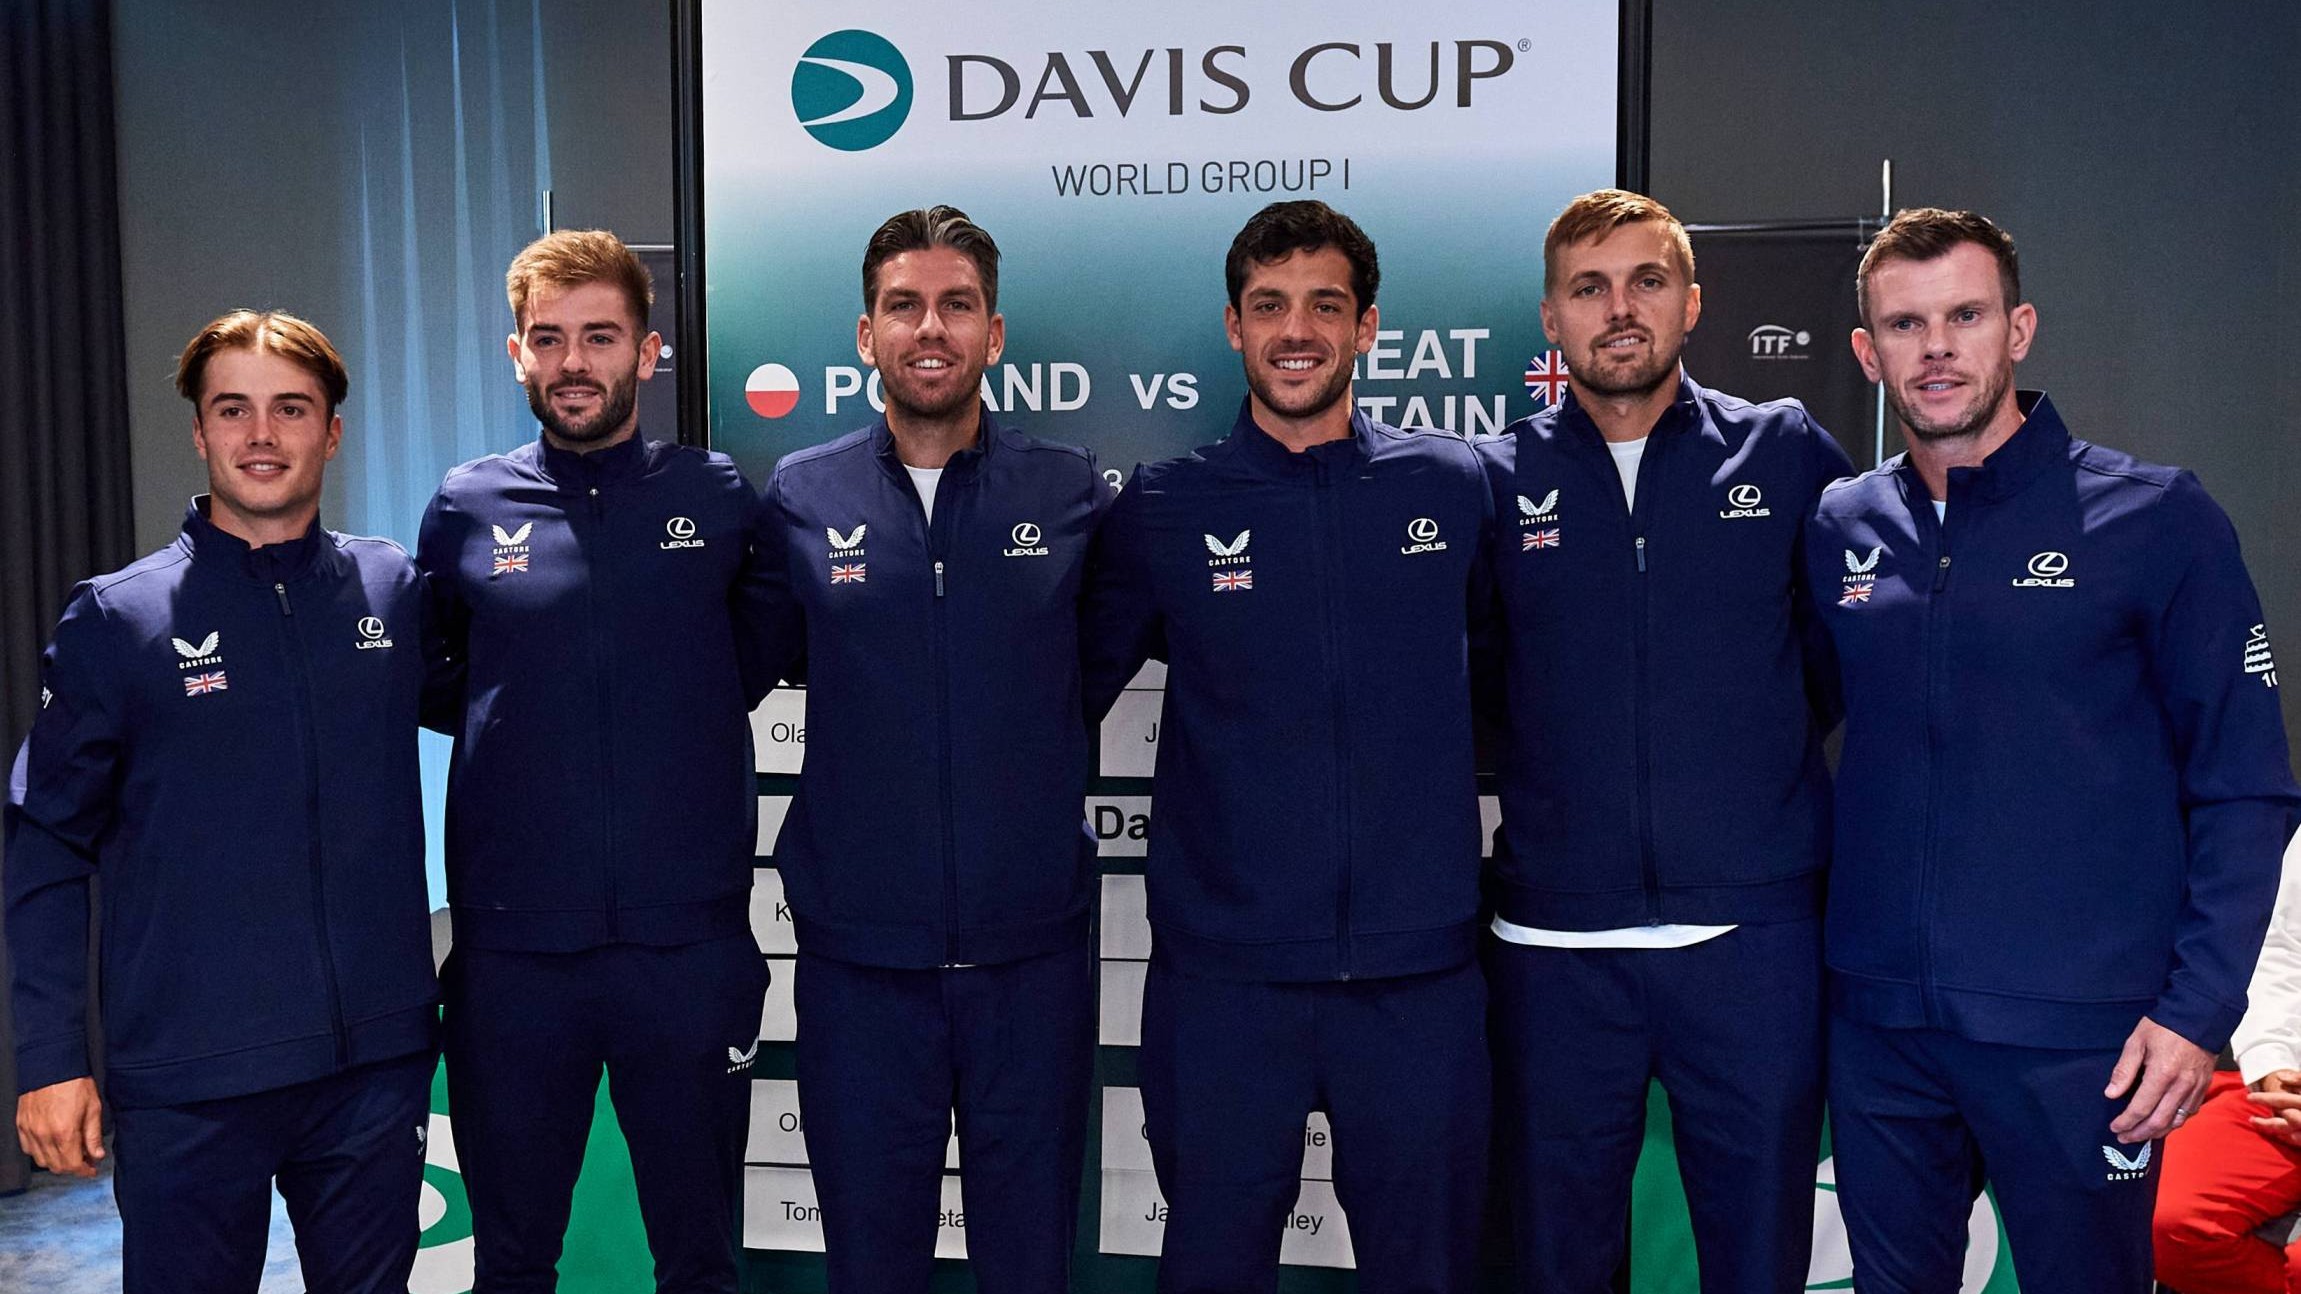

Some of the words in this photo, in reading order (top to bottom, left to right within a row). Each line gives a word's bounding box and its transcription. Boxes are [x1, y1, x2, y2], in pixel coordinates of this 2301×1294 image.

[946, 45, 1251, 121] DAVIS
[1288, 39, 1514, 112] CUP
[1052, 162, 1190, 197] WORLD
[1201, 158, 1332, 194] GROUP
[1344, 157, 1350, 190] I
[1752, 335, 1792, 354] ITF
[1720, 508, 1771, 519] LEXUS
[1519, 513, 1559, 526] CASTORE
[660, 539, 705, 550] LEXUS
[1401, 541, 1447, 555] LEXUS
[828, 549, 865, 559] CASTORE
[1003, 547, 1049, 557] LEXUS
[1208, 556, 1251, 567] CASTORE
[2012, 578, 2075, 588] LEXUS
[355, 639, 393, 650] LEXUS
[179, 655, 223, 669] CASTORE
